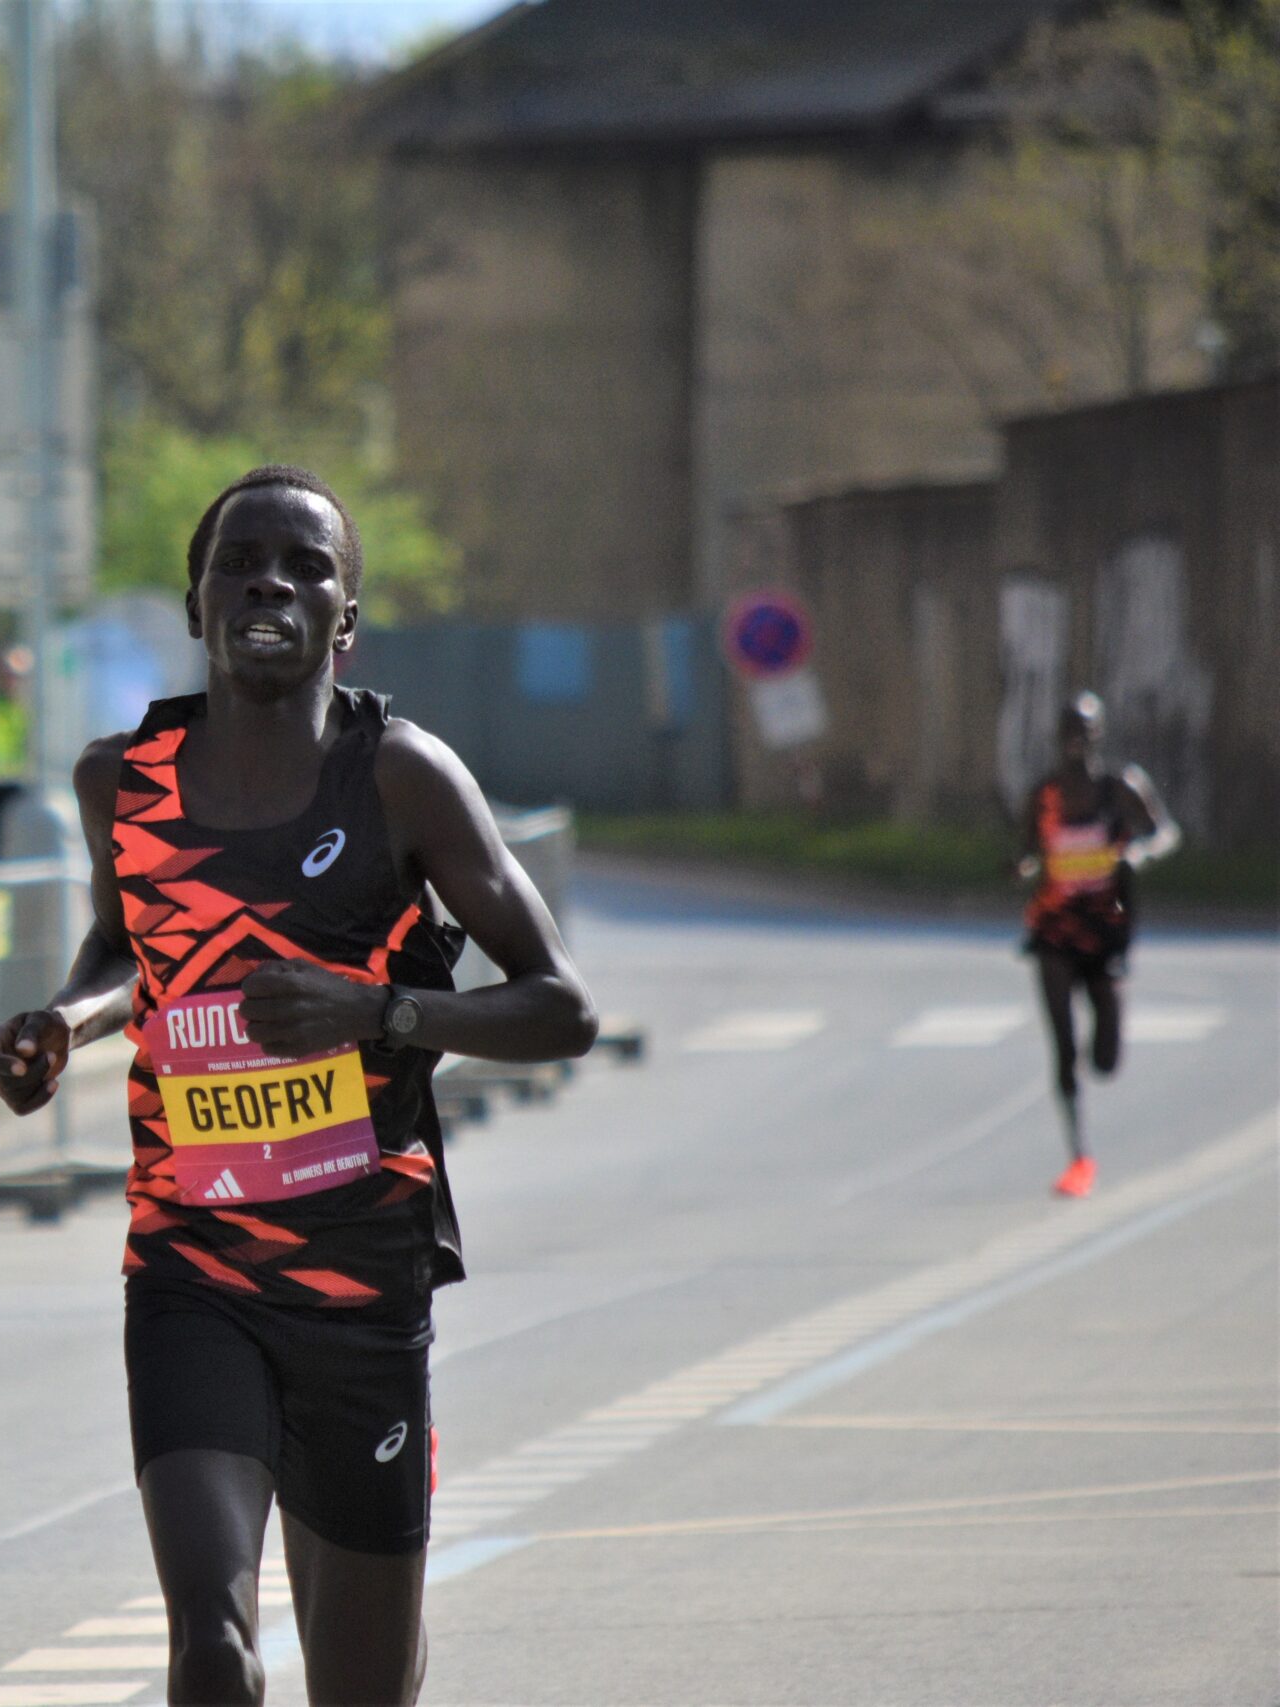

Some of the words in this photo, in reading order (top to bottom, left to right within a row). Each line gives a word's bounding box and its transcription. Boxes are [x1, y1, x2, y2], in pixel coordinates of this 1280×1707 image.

[166, 1003, 250, 1049] RUNC
[207, 1061, 231, 1071] PRAGUE
[231, 1060, 246, 1070] HALF
[247, 1057, 280, 1068] MARATHON
[185, 1069, 336, 1132] GEOFRY
[263, 1143, 272, 1160] 2
[282, 1171, 294, 1185] ALL
[293, 1163, 323, 1182] RUNNERS
[323, 1160, 336, 1174] ARE
